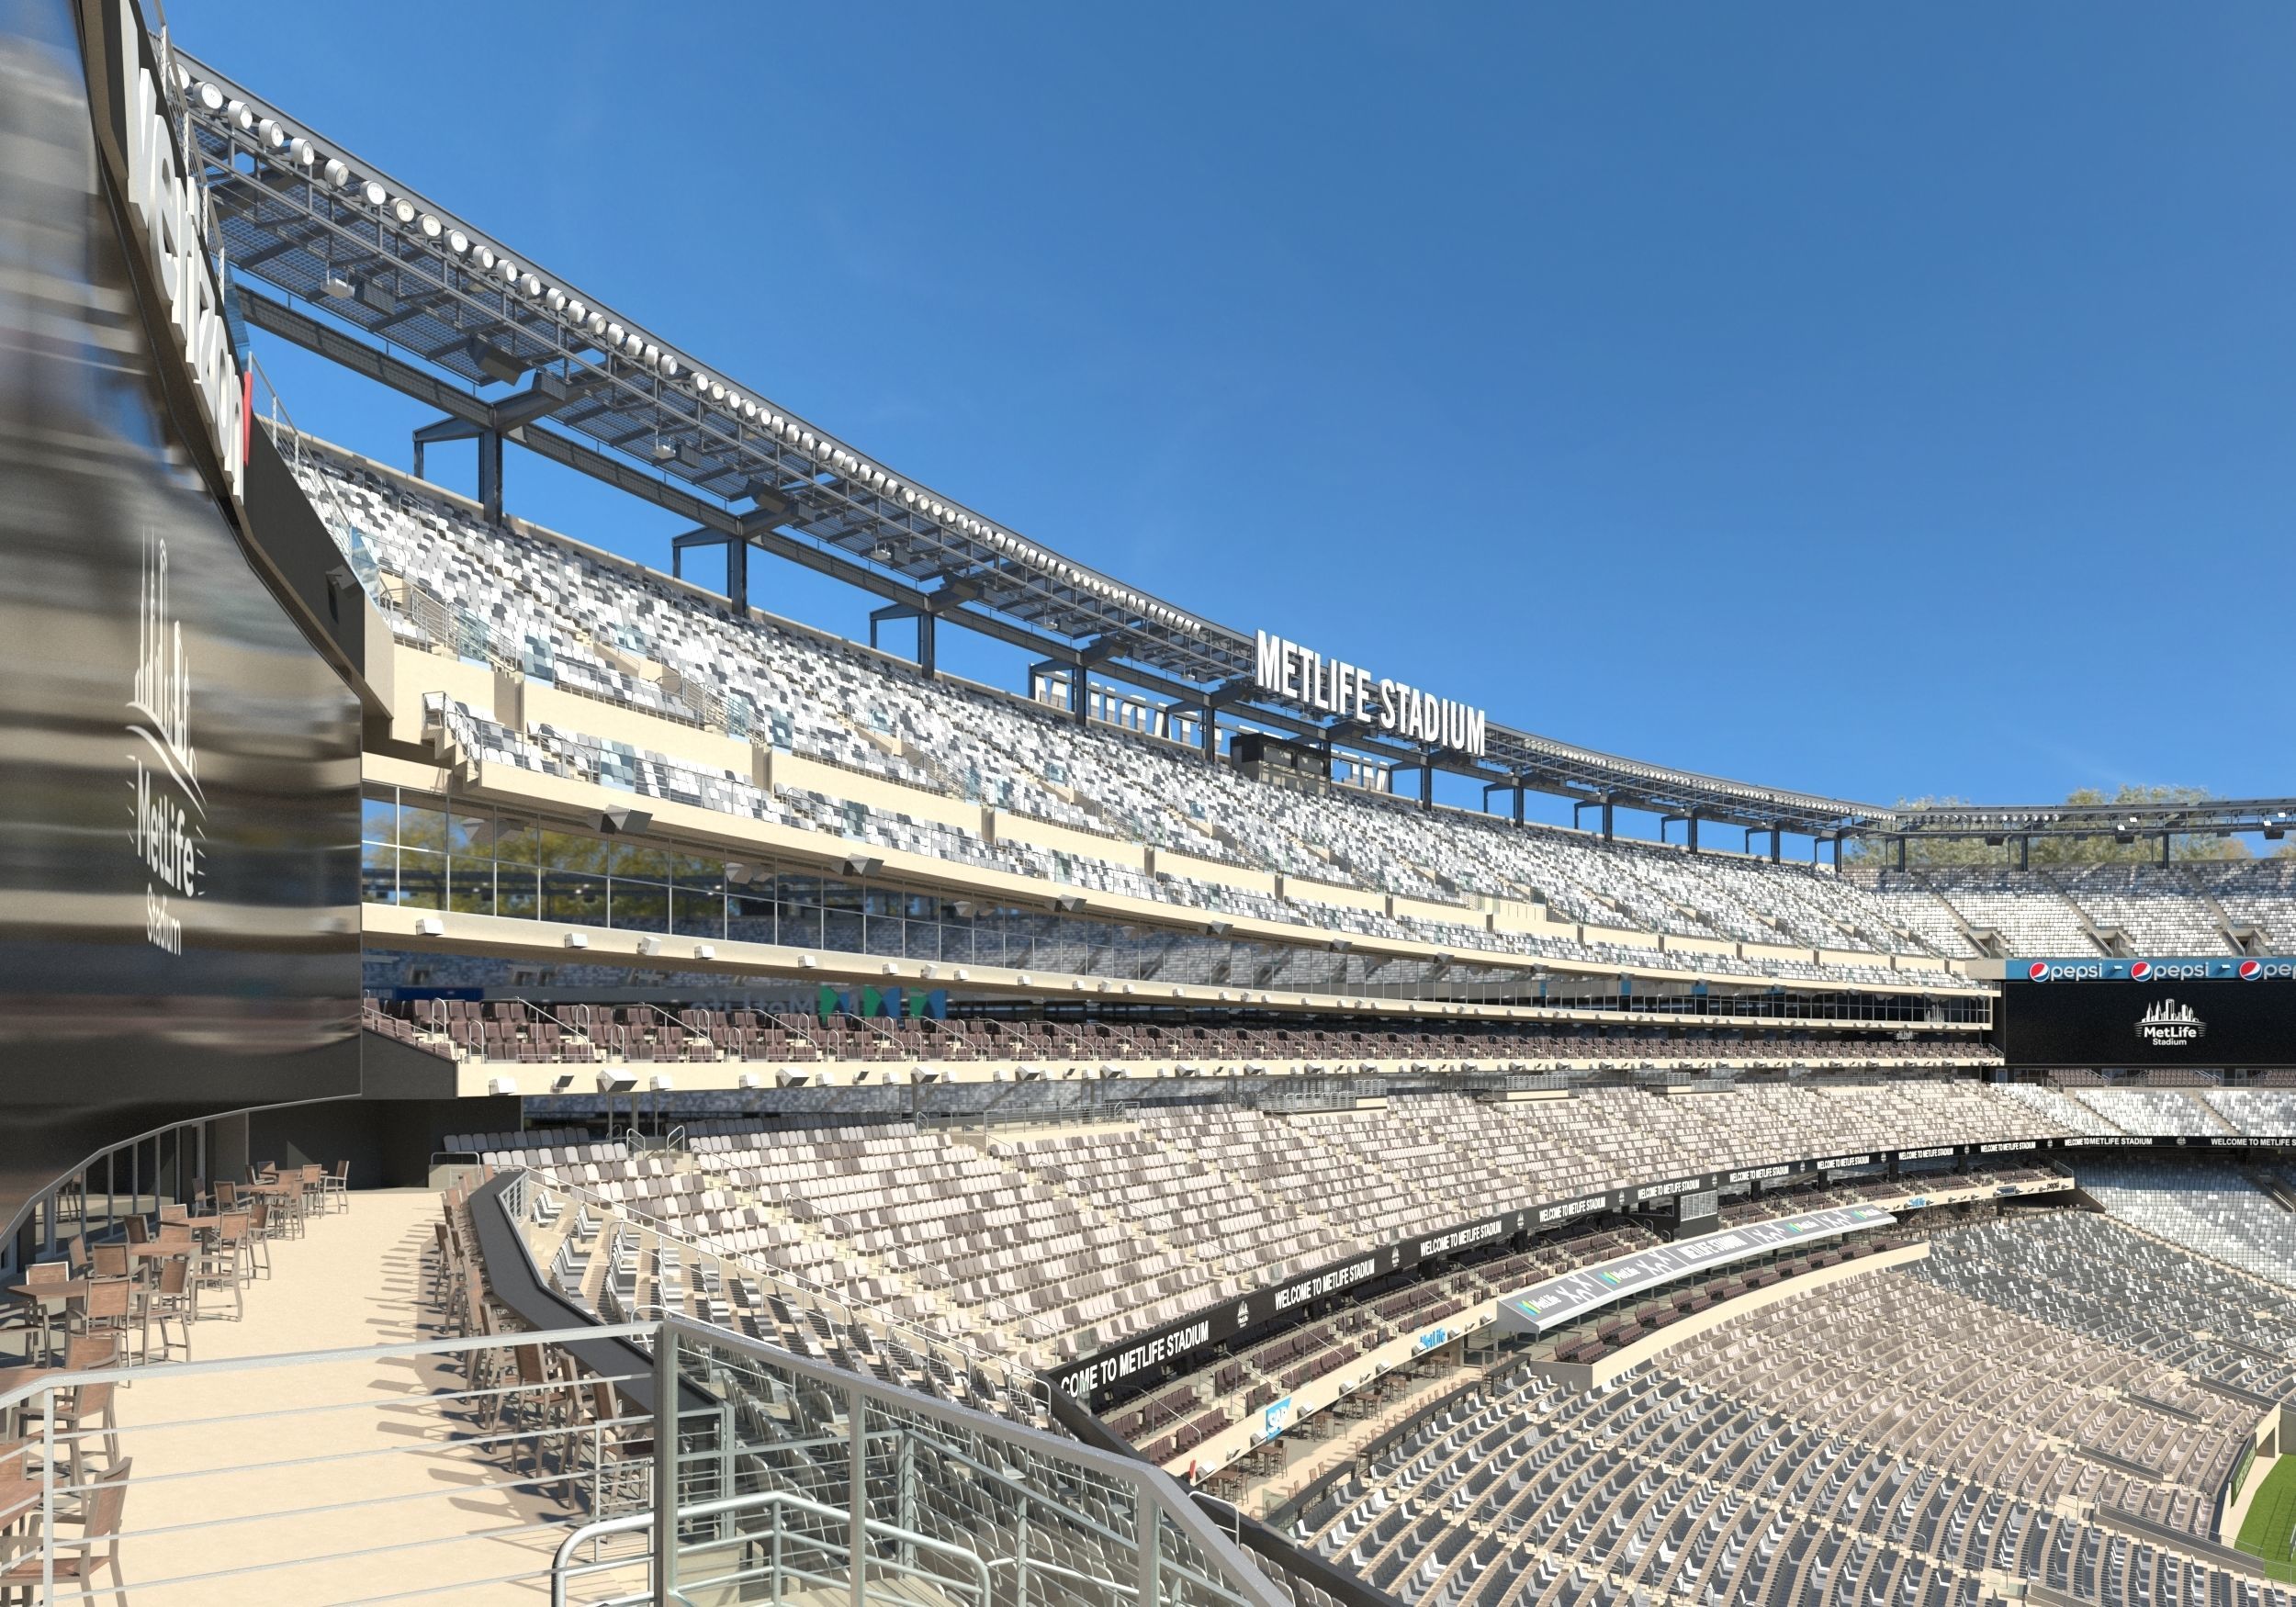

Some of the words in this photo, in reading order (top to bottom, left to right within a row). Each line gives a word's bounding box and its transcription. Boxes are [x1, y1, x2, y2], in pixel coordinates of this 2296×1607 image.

[1255, 629, 1371, 724] METLIFE
[1379, 678, 1485, 757] STADIUM
[138, 759, 195, 897] MetLife
[147, 882, 181, 956] Stadium
[2050, 963, 2102, 981] pepsi
[2154, 961, 2209, 981] pepsi
[2144, 1026, 2197, 1038] MetLife
[2065, 1138, 2083, 1147] WELCOME
[2084, 1137, 2089, 1145] TO
[2090, 1137, 2119, 1145] METLIFE
[2122, 1137, 2152, 1145] STADIUM
[2212, 1138, 2246, 1146] WELCOME
[2249, 1138, 2258, 1146] TO
[2260, 1138, 2290, 1146] METLIFE
[1818, 1159, 1836, 1170] WELCOME
[1836, 1158, 1840, 1168] TO
[1840, 1156, 1854, 1167] METLIFE
[1855, 1155, 1869, 1165] STADIUM
[1729, 1171, 1749, 1183] WELCOME
[1750, 1170, 1755, 1179] TO
[1756, 1168, 1772, 1178] METLIFE
[1773, 1165, 1789, 1176] STADIUM
[1638, 1186, 1657, 1200] WELCOME
[1658, 1186, 1663, 1196] TO
[1663, 1182, 1681, 1195] METLIFE
[1682, 1179, 1699, 1191] STADIUM
[1539, 1206, 1561, 1222] WELCOME
[1562, 1205, 1568, 1217] TO
[1569, 1200, 1586, 1215] METLIFE
[1586, 1197, 1605, 1211] STADIUM
[1421, 1235, 1449, 1256] WELCOME
[1450, 1233, 1458, 1247] TO
[1458, 1227, 1480, 1245] METLIFE
[1480, 1220, 1502, 1238] STADIUM
[1676, 1241, 1714, 1259] METLIFE
[1276, 1281, 1311, 1310] WELCOME
[1312, 1277, 1322, 1296] TO
[1323, 1267, 1348, 1292] METLIFE
[1350, 1258, 1374, 1282] STADIUM
[1100, 1357, 1117, 1385] TO
[1120, 1338, 1165, 1377] METLIFE
[1167, 1320, 1208, 1356] STADIUM
[1267, 1406, 1288, 1434] SAP
